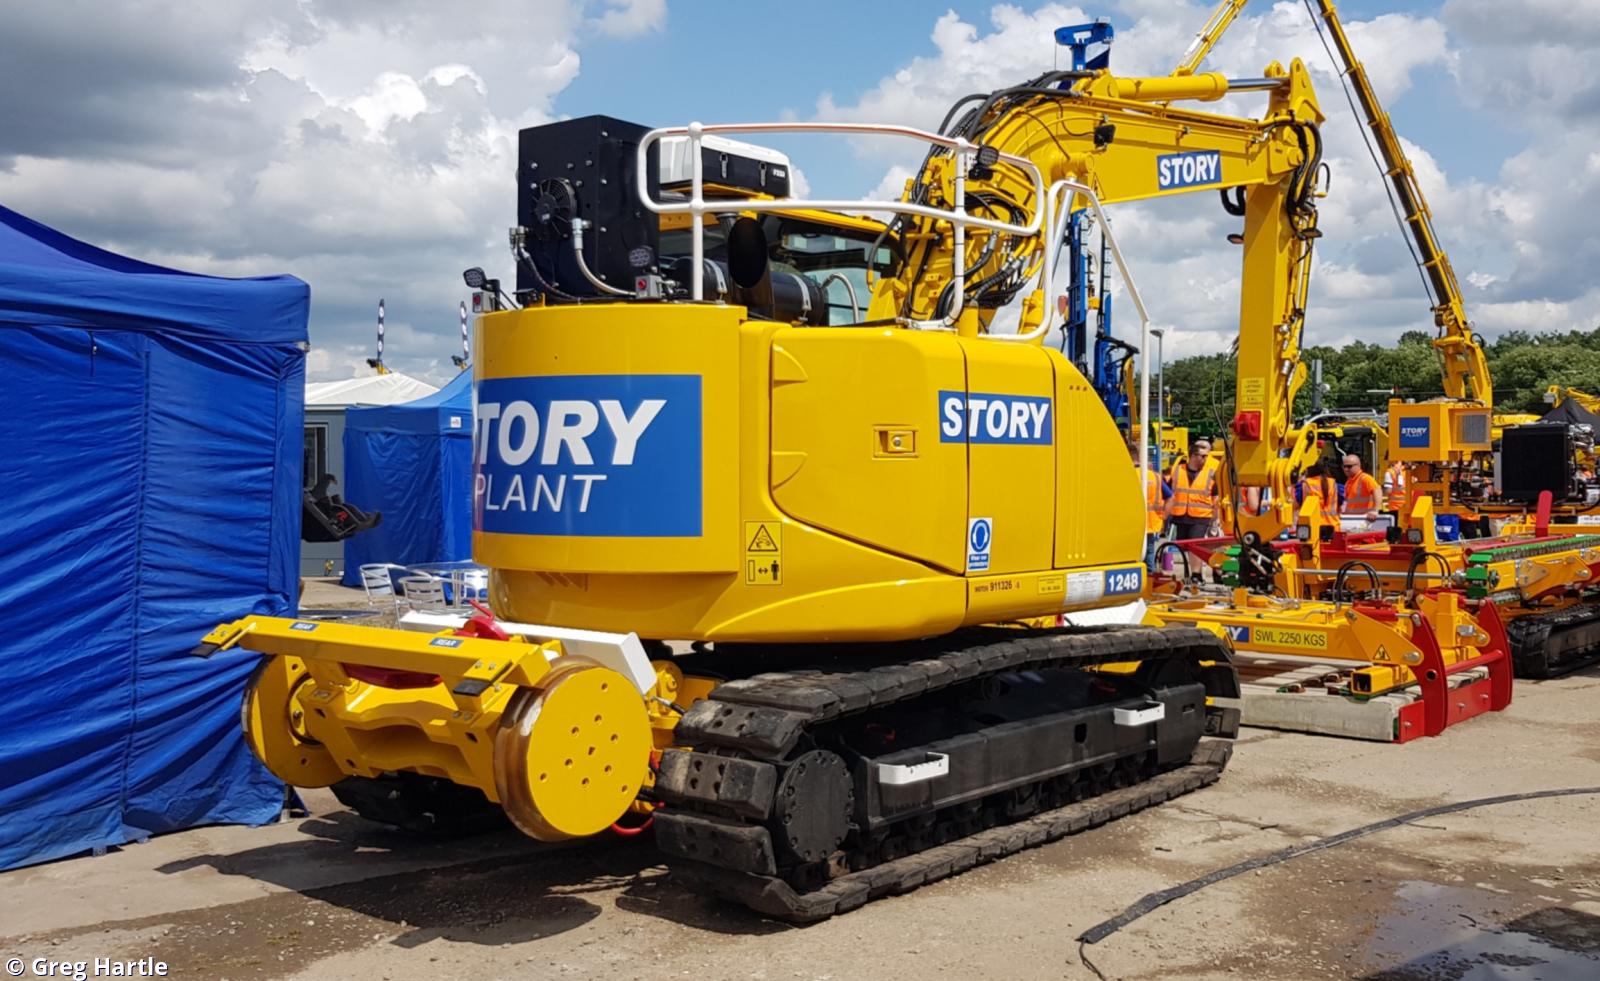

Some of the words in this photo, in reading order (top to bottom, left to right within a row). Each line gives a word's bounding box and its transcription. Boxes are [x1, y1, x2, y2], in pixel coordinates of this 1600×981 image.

[1160, 154, 1219, 186] STORY
[474, 399, 667, 466] TORY
[942, 397, 1049, 439] STORY
[474, 473, 607, 512] PLANT
[990, 579, 1013, 592] 911326
[1108, 572, 1139, 592] 1248
[1255, 629, 1276, 642] SWL
[1279, 631, 1302, 645] 2250
[1304, 633, 1326, 647] KGS
